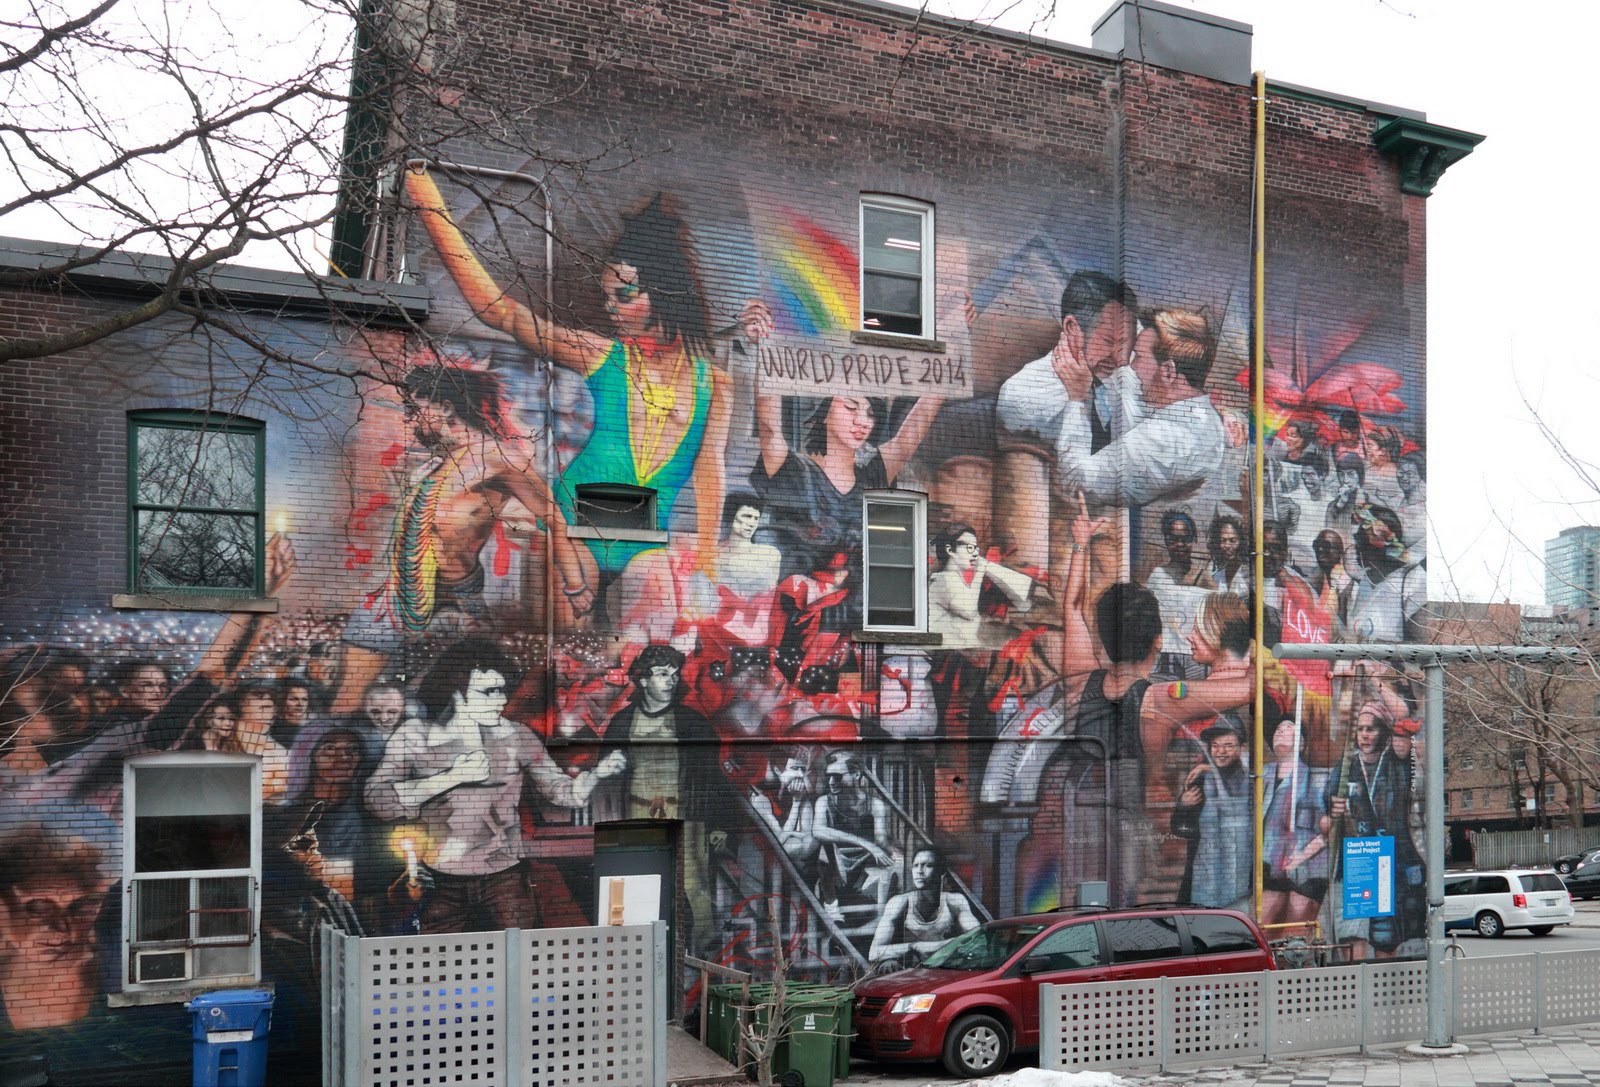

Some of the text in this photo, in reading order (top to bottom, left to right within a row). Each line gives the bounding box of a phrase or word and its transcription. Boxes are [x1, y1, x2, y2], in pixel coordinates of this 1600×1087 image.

[760, 346, 966, 387] WORLD PRIDE 2014
[1286, 599, 1327, 643] LOVE
